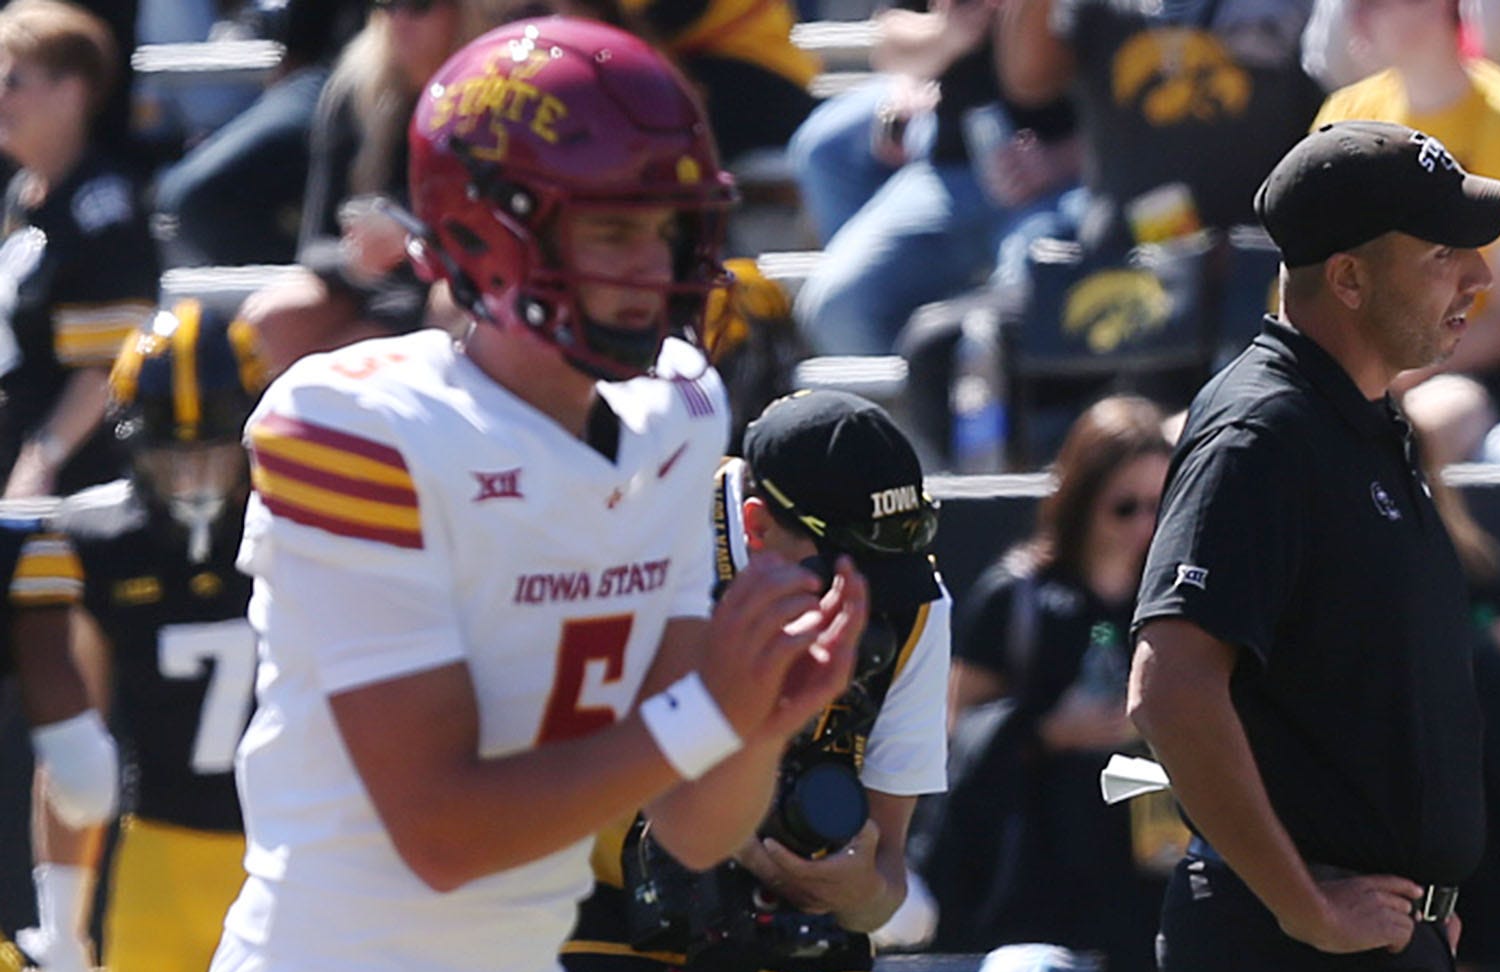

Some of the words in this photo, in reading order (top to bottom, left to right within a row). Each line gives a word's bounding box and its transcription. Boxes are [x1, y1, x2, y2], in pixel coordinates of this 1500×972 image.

[428, 76, 569, 144] STATE
[871, 484, 919, 519] IOWA
[513, 571, 591, 605] IOWA
[156, 617, 258, 775] 7
